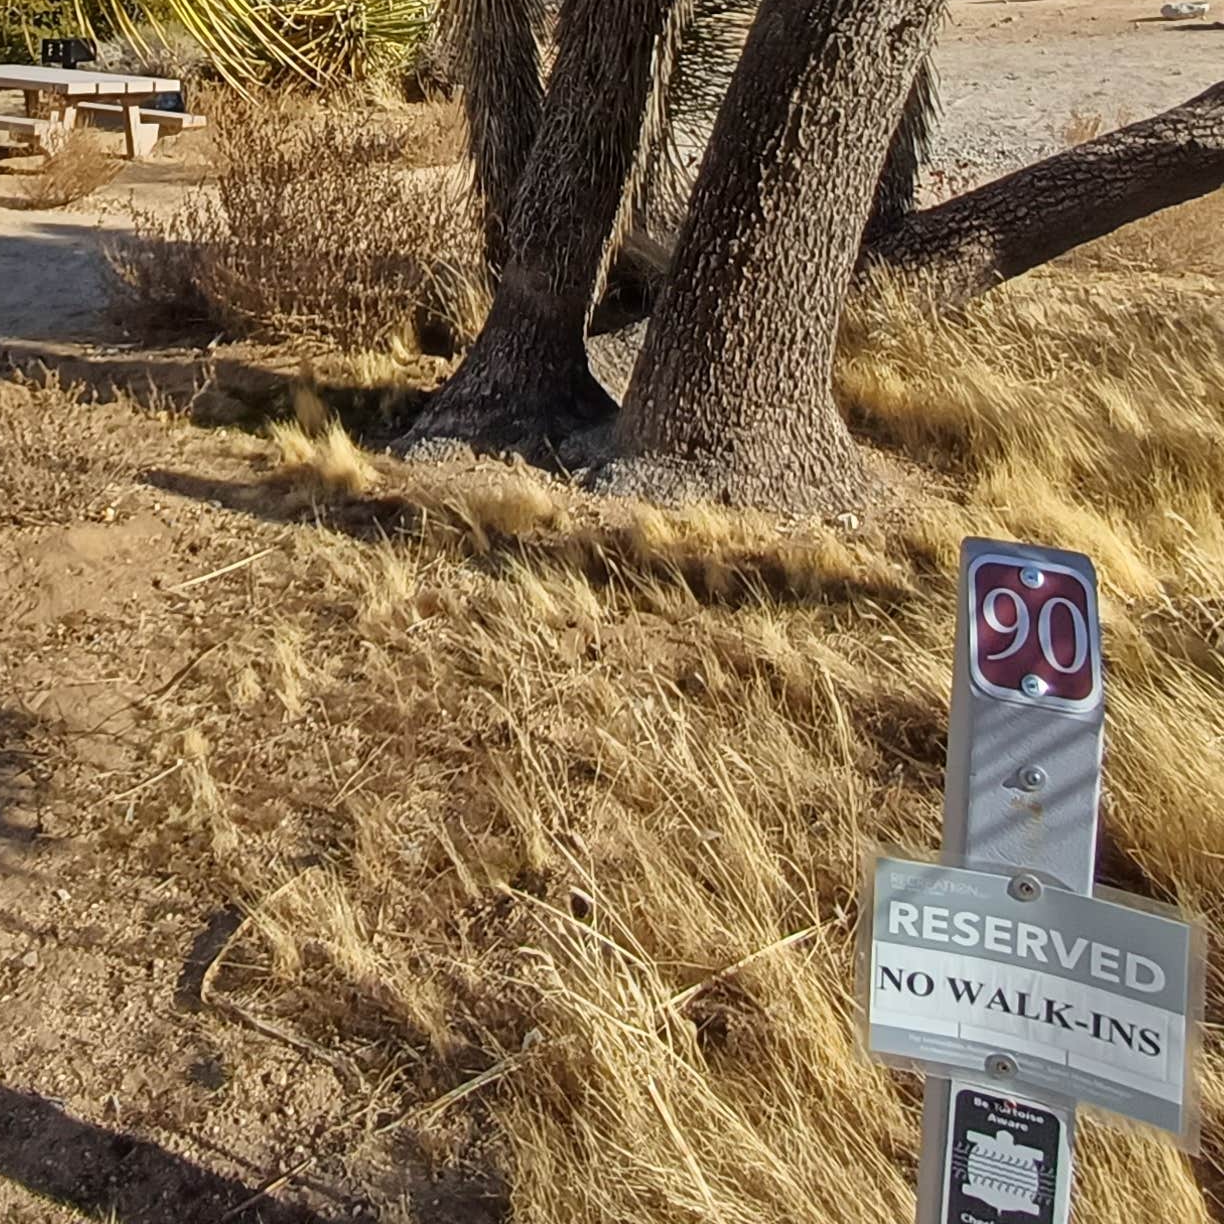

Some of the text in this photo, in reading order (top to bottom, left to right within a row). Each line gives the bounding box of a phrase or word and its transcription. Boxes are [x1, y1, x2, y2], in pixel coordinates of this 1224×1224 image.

[983, 588, 1088, 673] 90
[888, 900, 1166, 993] RESERVED
[877, 966, 935, 997] NO
[945, 976, 1162, 1057] WALK-INS
[973, 1096, 989, 1109] Be
[986, 1112, 1029, 1132] Aware
